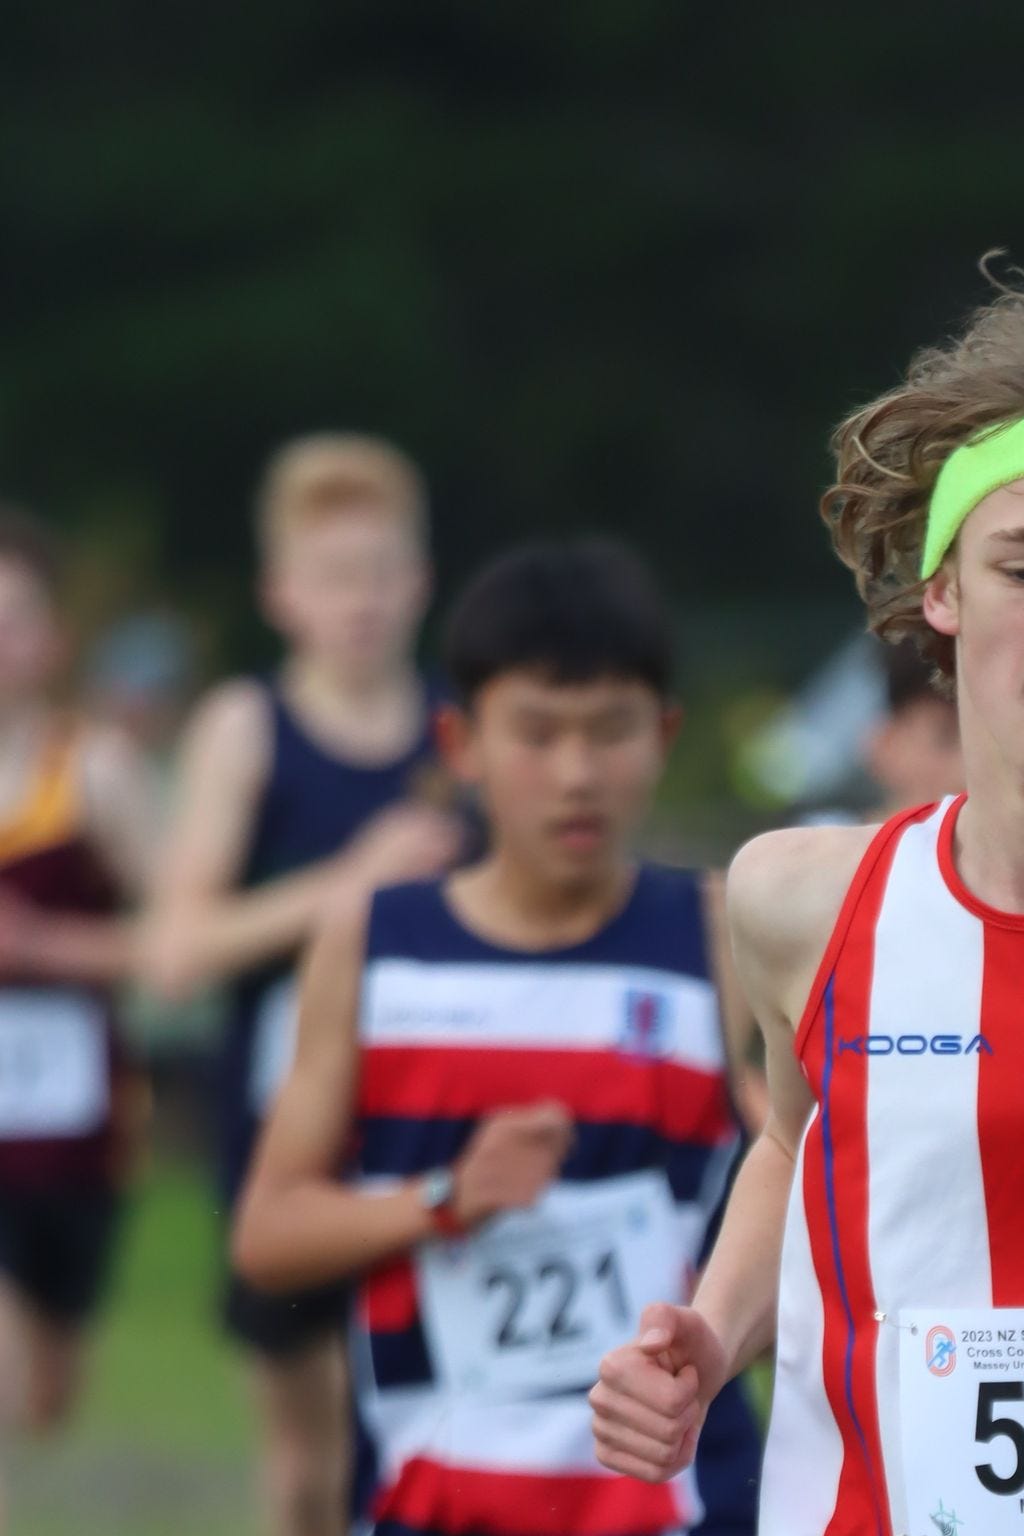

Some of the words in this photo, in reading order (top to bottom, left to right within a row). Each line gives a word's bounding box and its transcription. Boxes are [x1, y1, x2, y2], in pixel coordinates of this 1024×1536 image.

[837, 1034, 994, 1056] KOOGA
[484, 1250, 629, 1348] 221
[961, 1330, 992, 1343] 2023
[997, 1330, 1016, 1342] NZ
[966, 1346, 1005, 1358] Cross
[973, 1361, 1010, 1371] Massey
